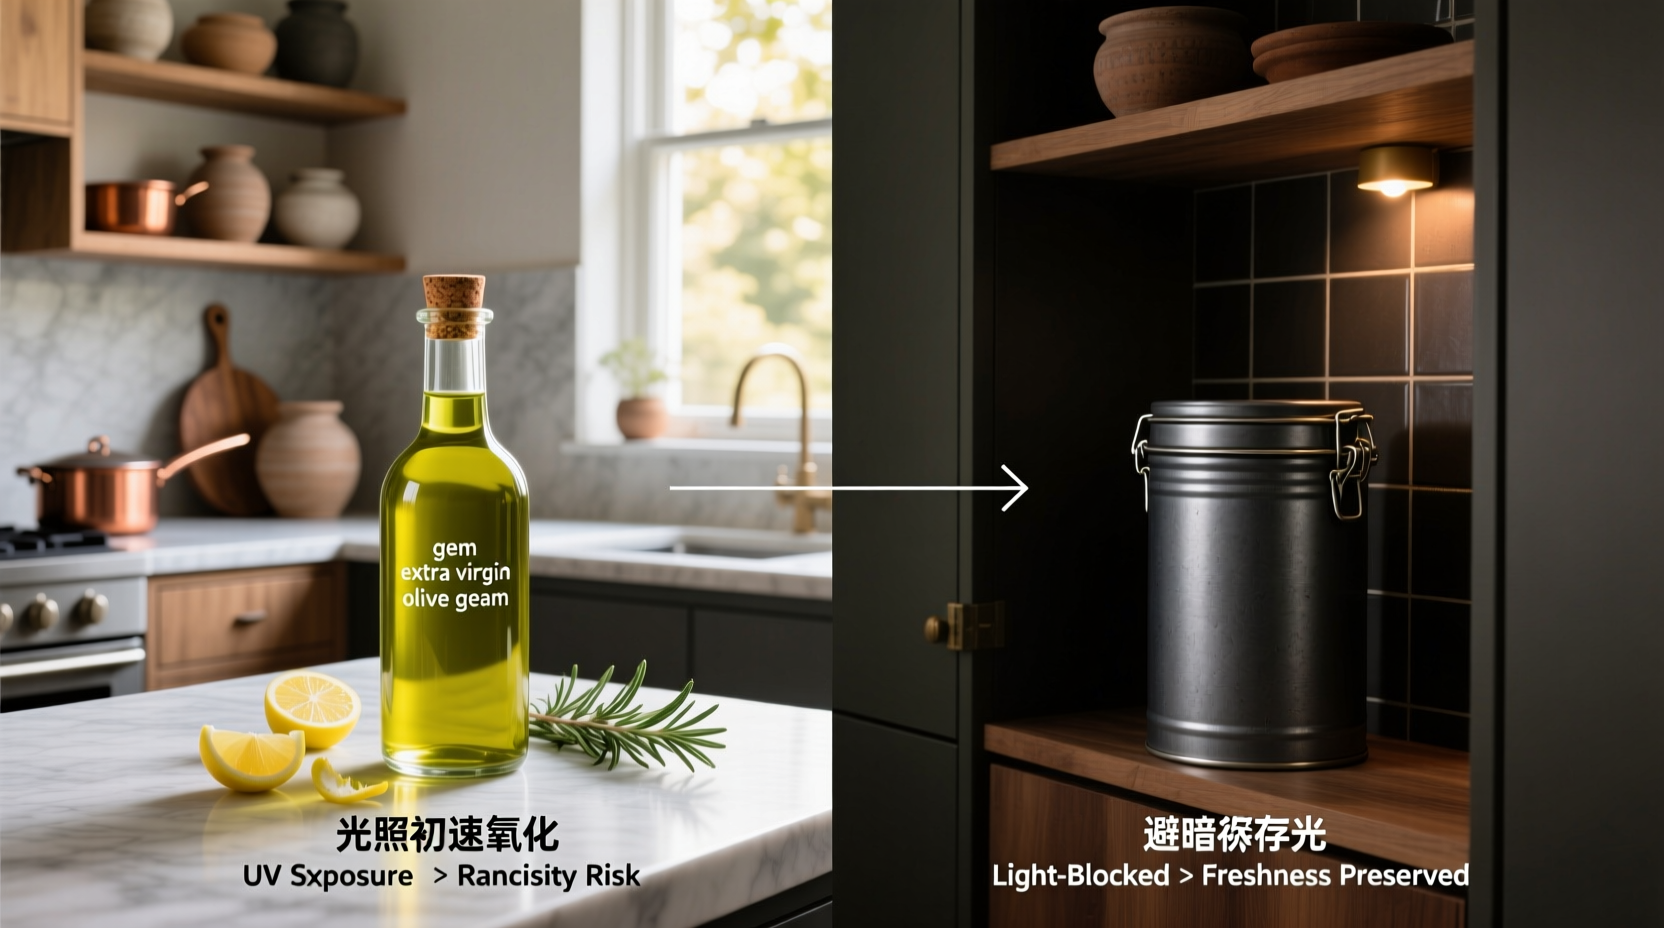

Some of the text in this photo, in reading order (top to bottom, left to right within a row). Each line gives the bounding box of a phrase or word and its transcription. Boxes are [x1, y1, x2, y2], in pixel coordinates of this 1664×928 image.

[432, 542, 477, 562] gem
[400, 561, 511, 586] extra virgin
[402, 587, 509, 613] olive geam
